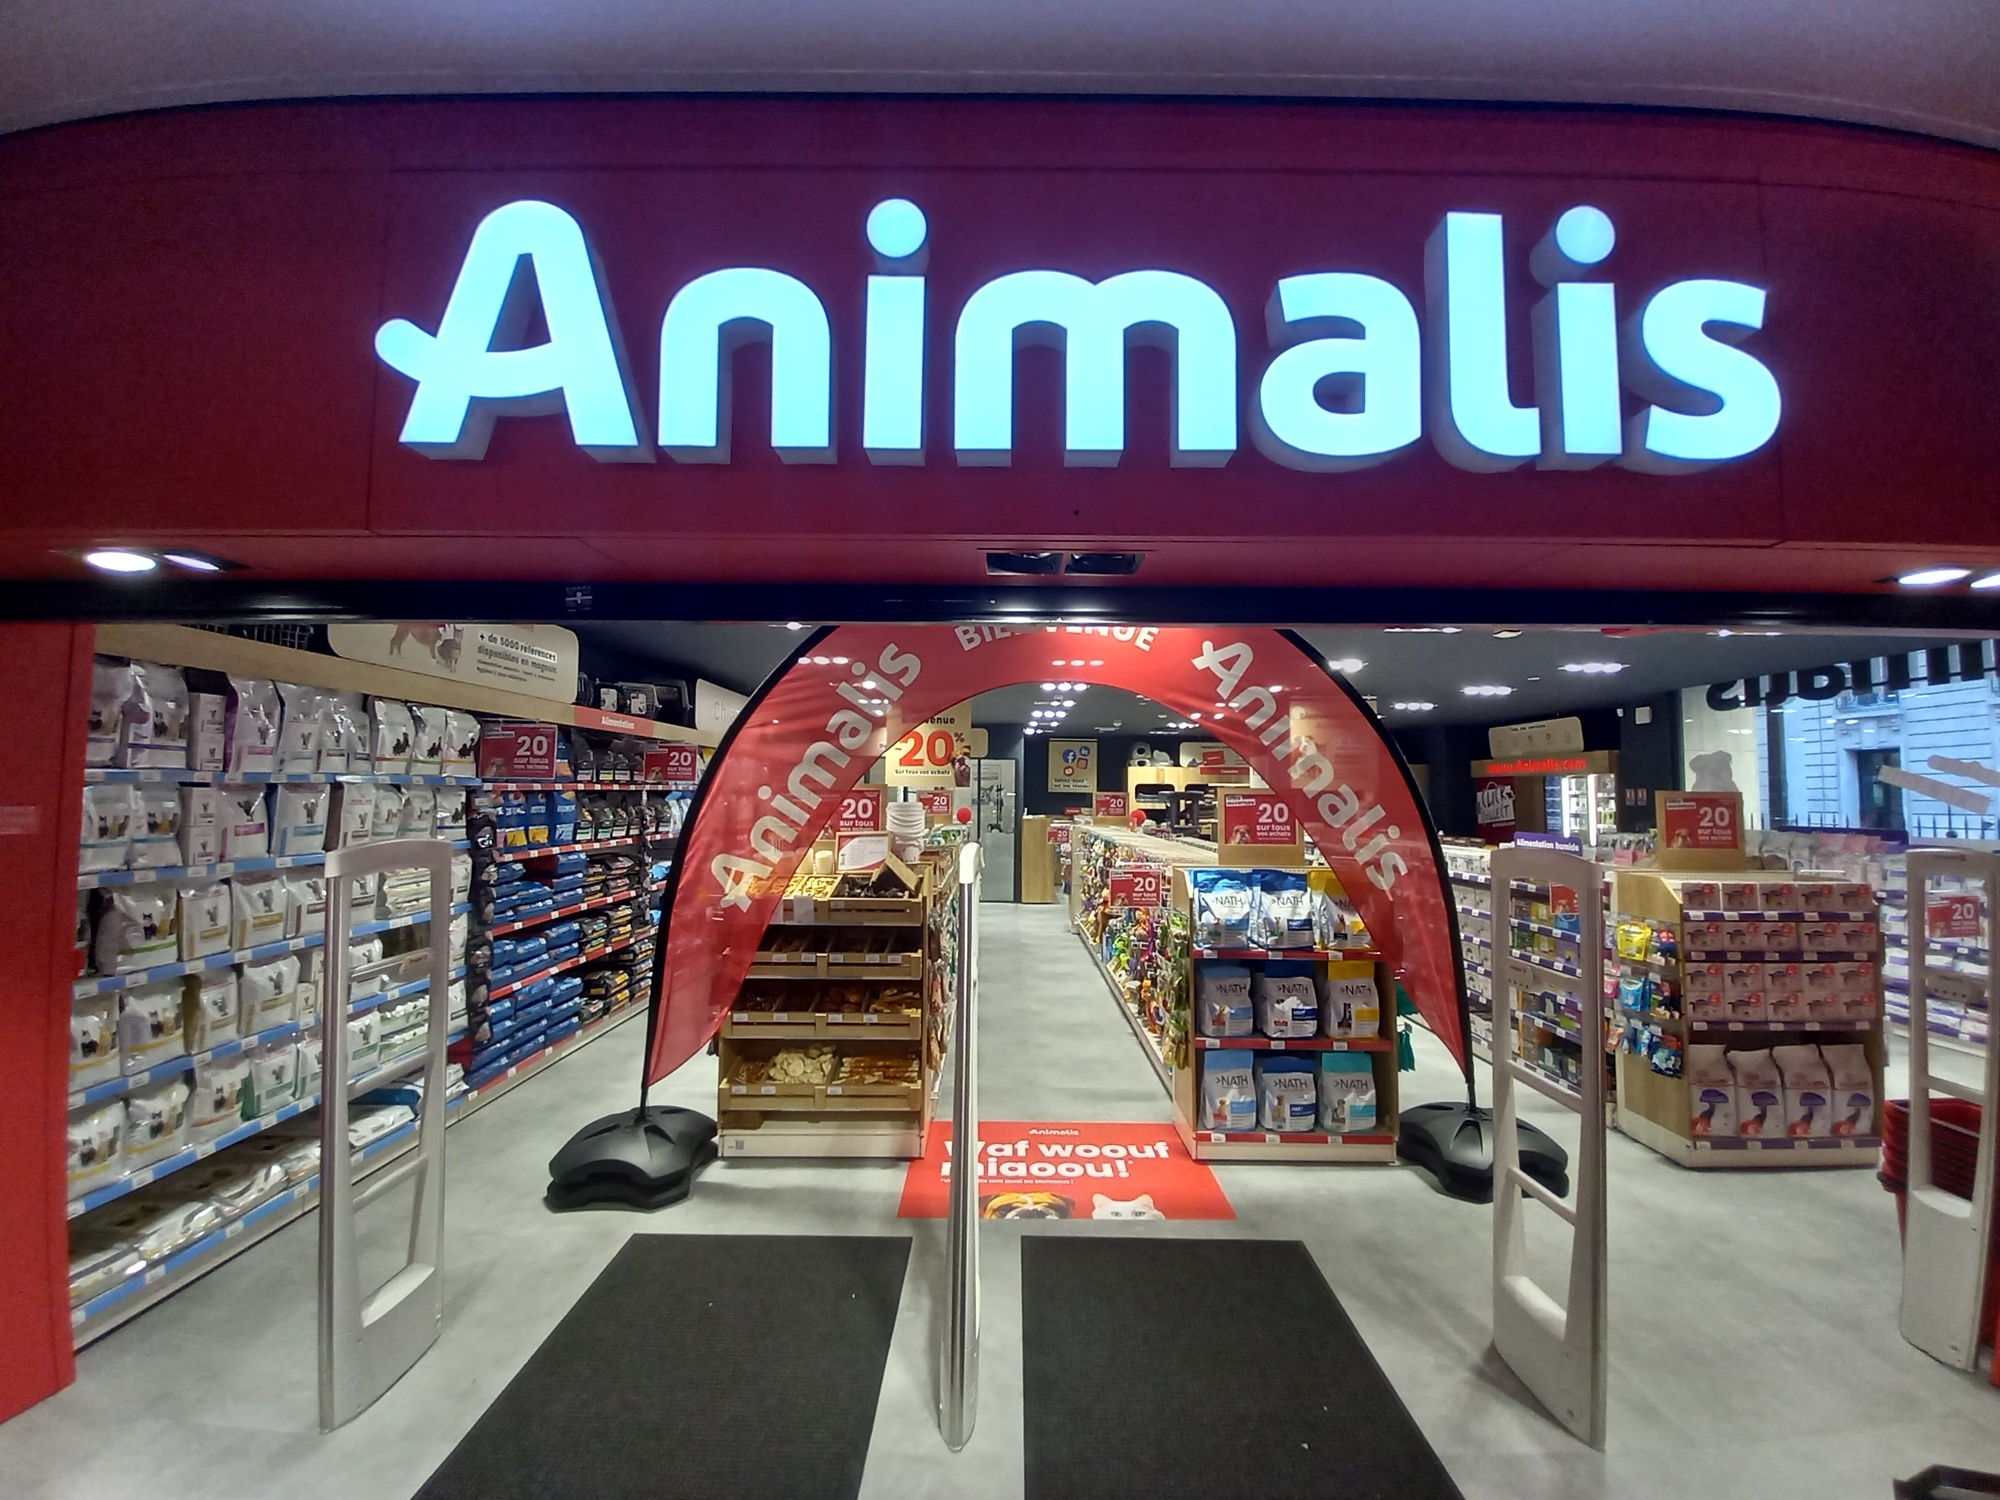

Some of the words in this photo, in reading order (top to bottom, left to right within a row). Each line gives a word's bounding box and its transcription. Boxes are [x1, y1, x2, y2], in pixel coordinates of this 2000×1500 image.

[374, 197, 1782, 460] Animalis
[500, 637, 520, 650] 5000
[1191, 641, 1408, 892] Animalis
[711, 643, 921, 912] Animalis
[855, 819, 874, 827] tous
[1272, 823, 1291, 831] tous
[1516, 838, 1555, 849] Alimentation
[1555, 841, 1580, 852] humide
[1028, 1128, 1080, 1136] Animalis
[1037, 1141, 1169, 1159] woouf
